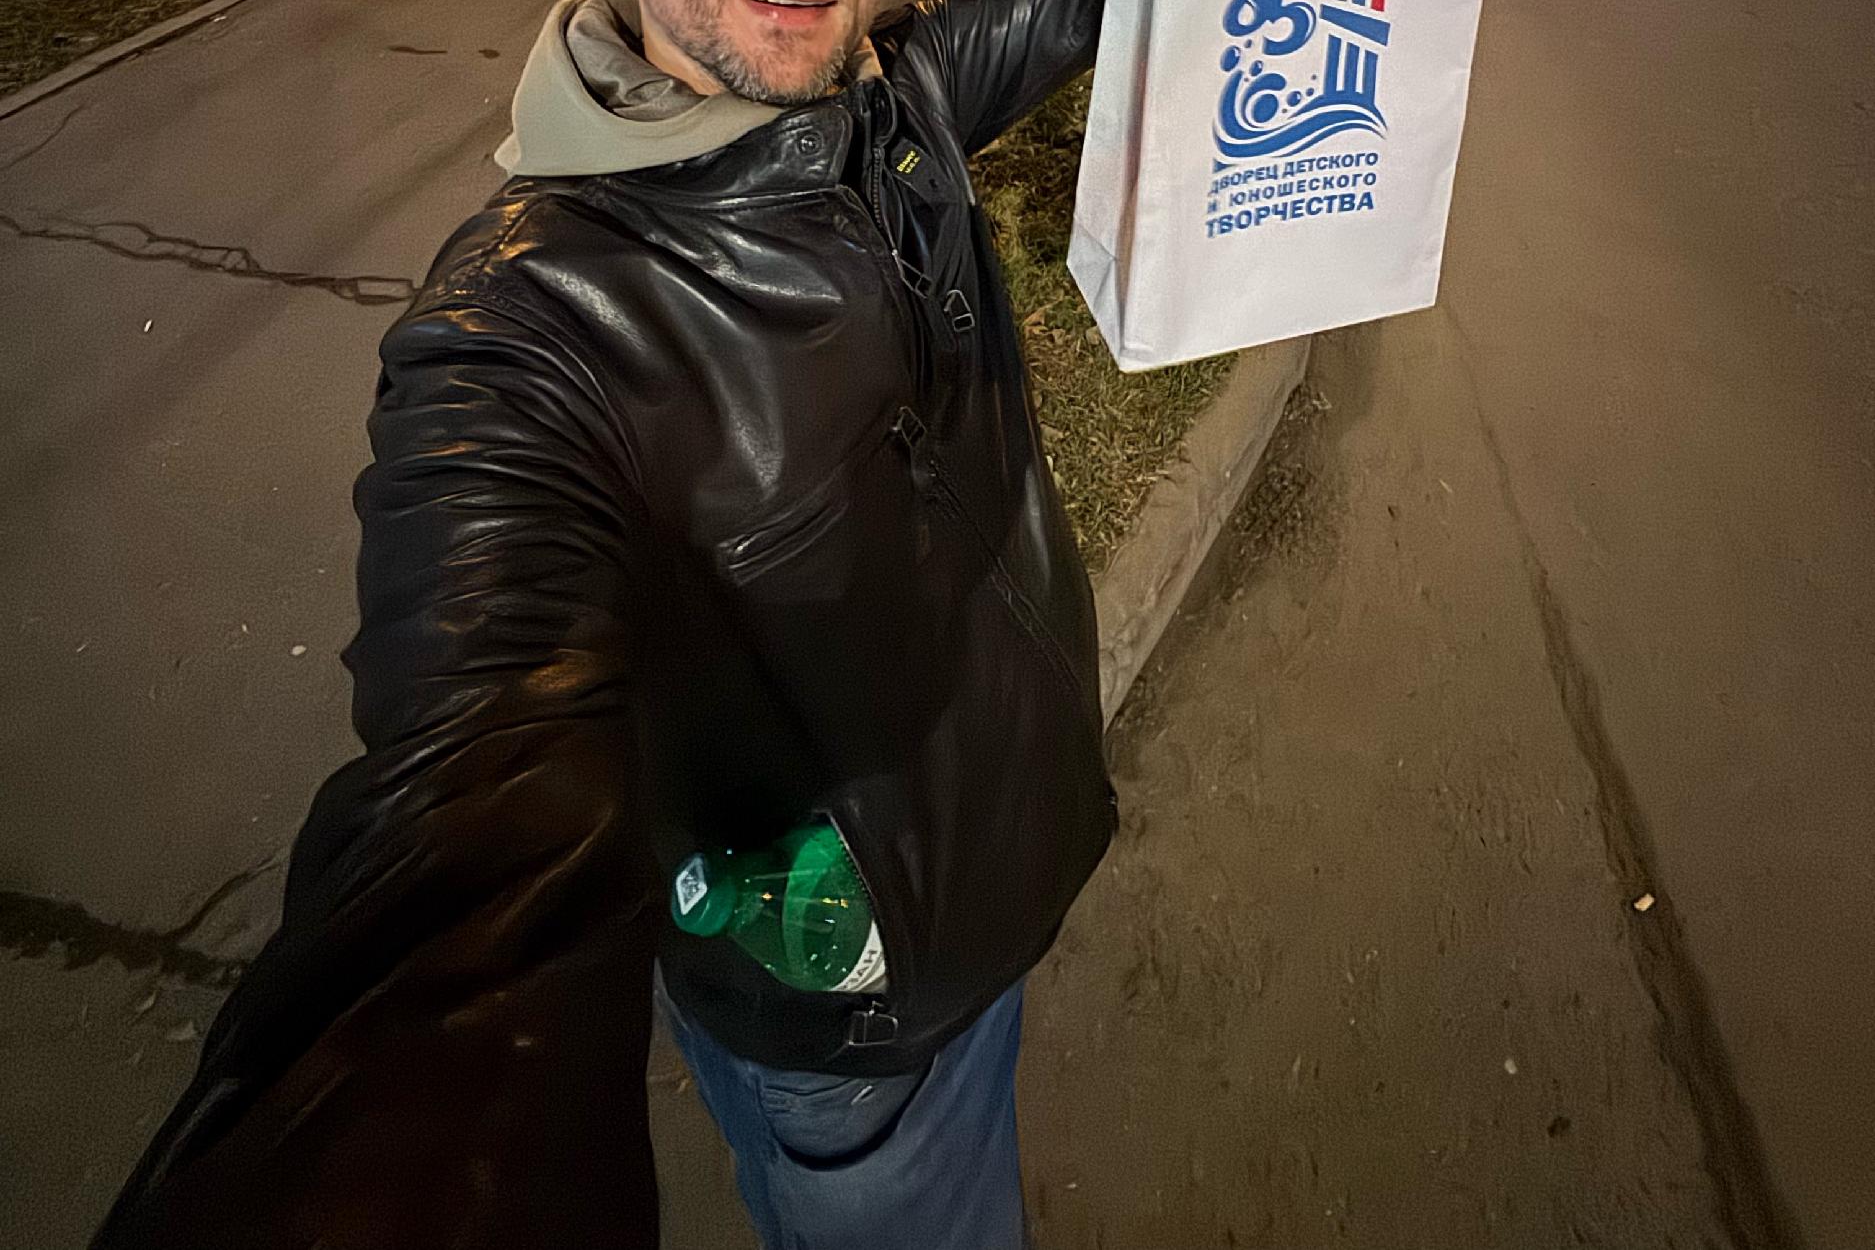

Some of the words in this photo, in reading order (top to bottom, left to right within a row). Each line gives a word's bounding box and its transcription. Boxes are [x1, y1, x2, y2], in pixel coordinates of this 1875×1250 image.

[1207, 199, 1218, 214] И
[1229, 172, 1377, 207] ЮНОШЕСКОГО
[1208, 164, 1278, 196] ДВОРЕЦ
[1282, 152, 1378, 178] ДЕТСКОГО
[1205, 191, 1374, 238] ТВОРЧЕСТВА
